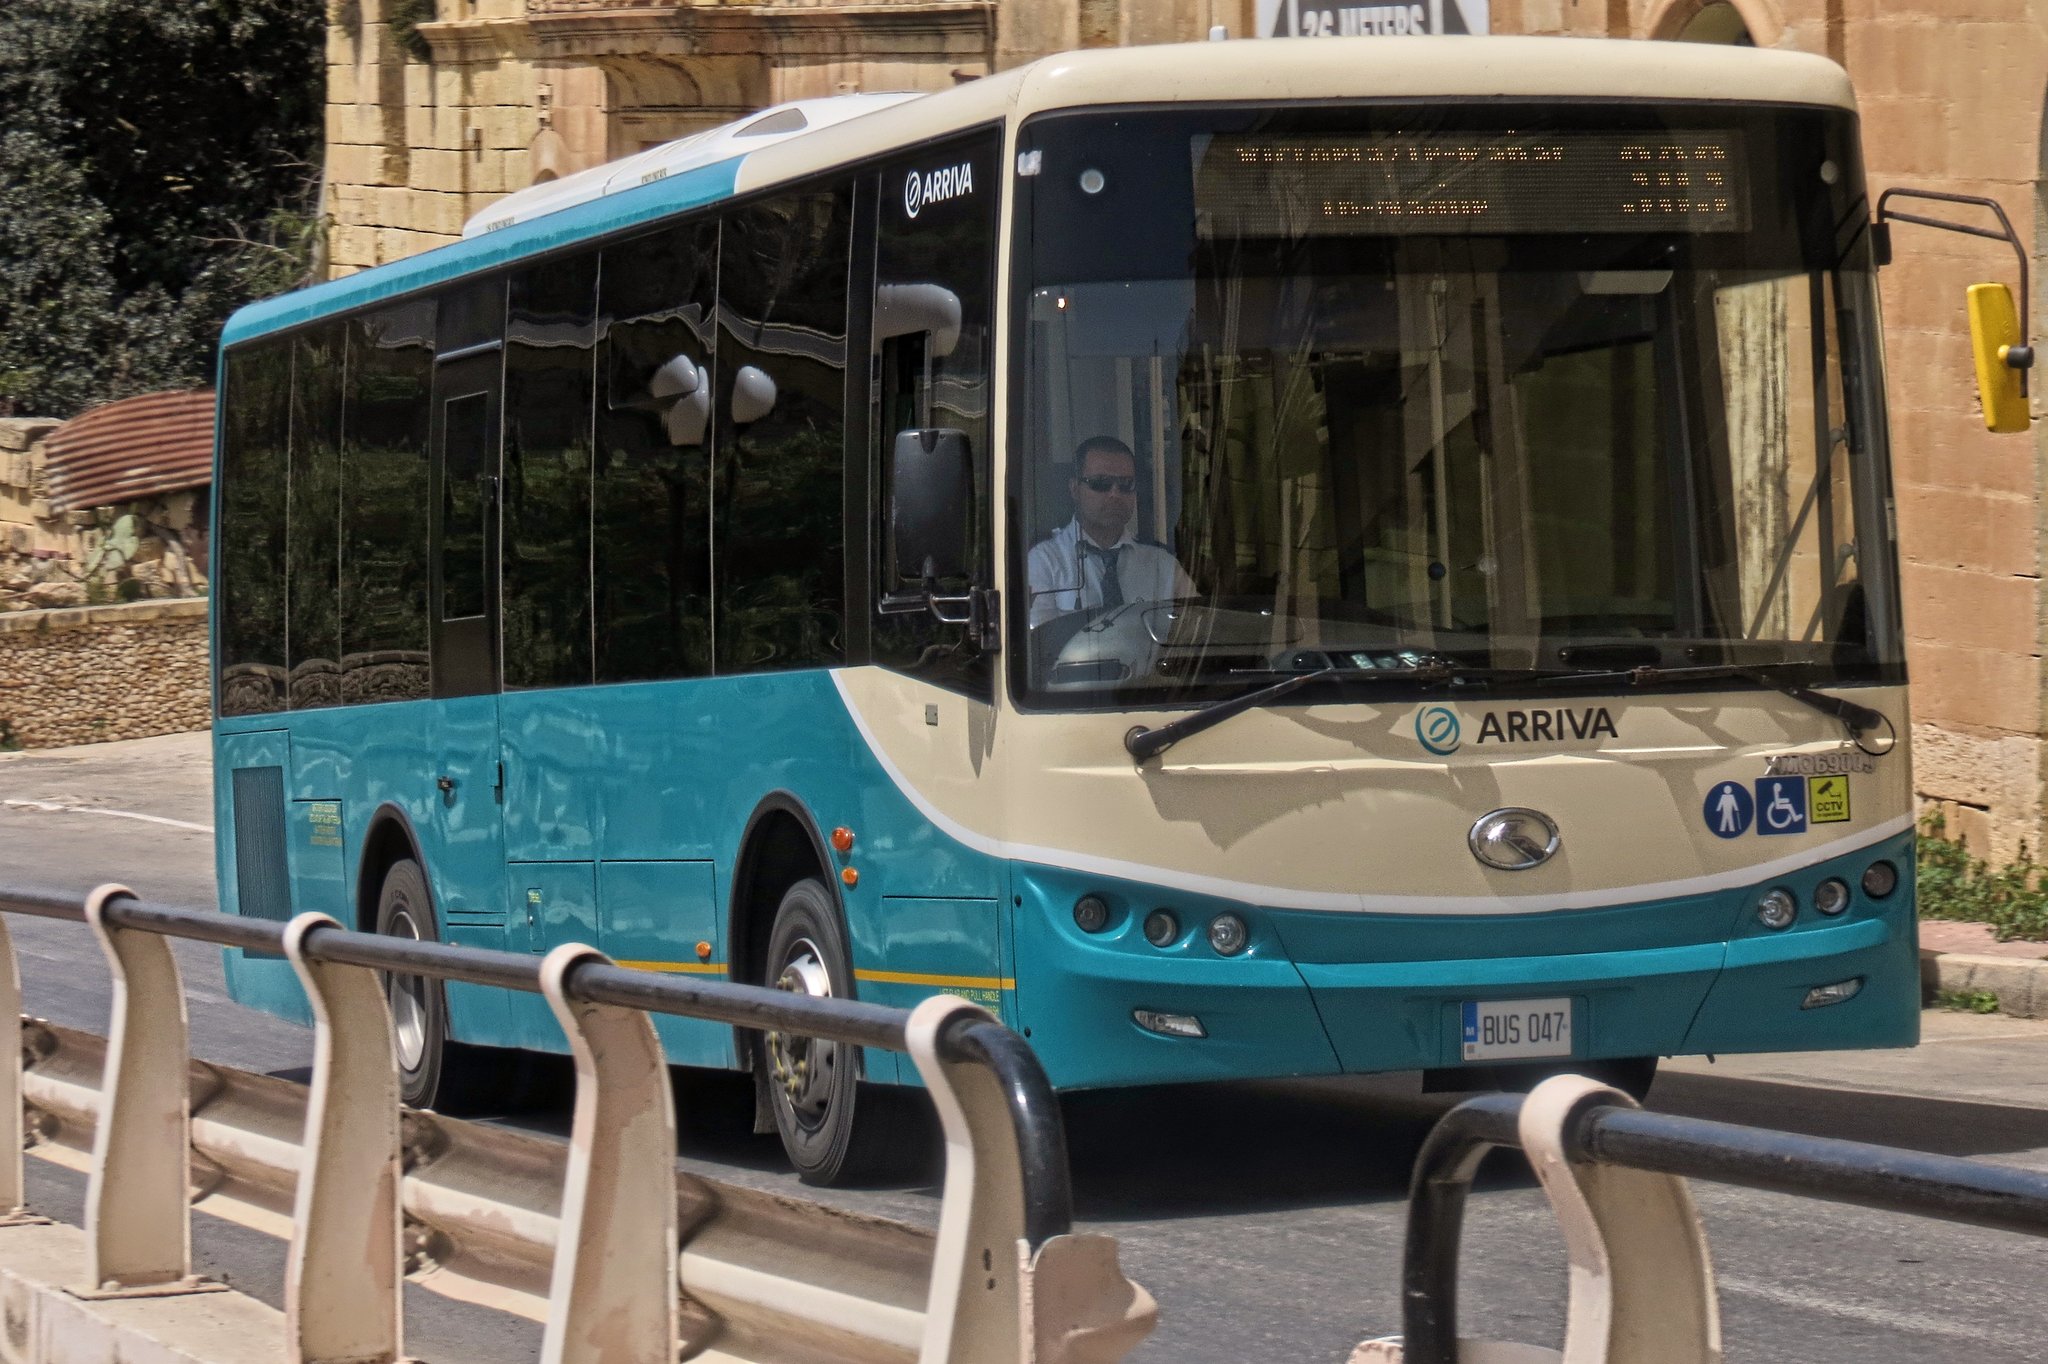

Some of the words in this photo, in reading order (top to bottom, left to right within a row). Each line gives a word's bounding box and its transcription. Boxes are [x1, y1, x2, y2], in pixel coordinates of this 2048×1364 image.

[922, 162, 973, 206] ARRIVA
[1477, 706, 1619, 744] ARRIVA
[1816, 801, 1843, 812] CCTV
[1466, 1026, 1475, 1037] M
[1483, 1013, 1520, 1046] BUS
[1528, 1011, 1565, 1043] 047
